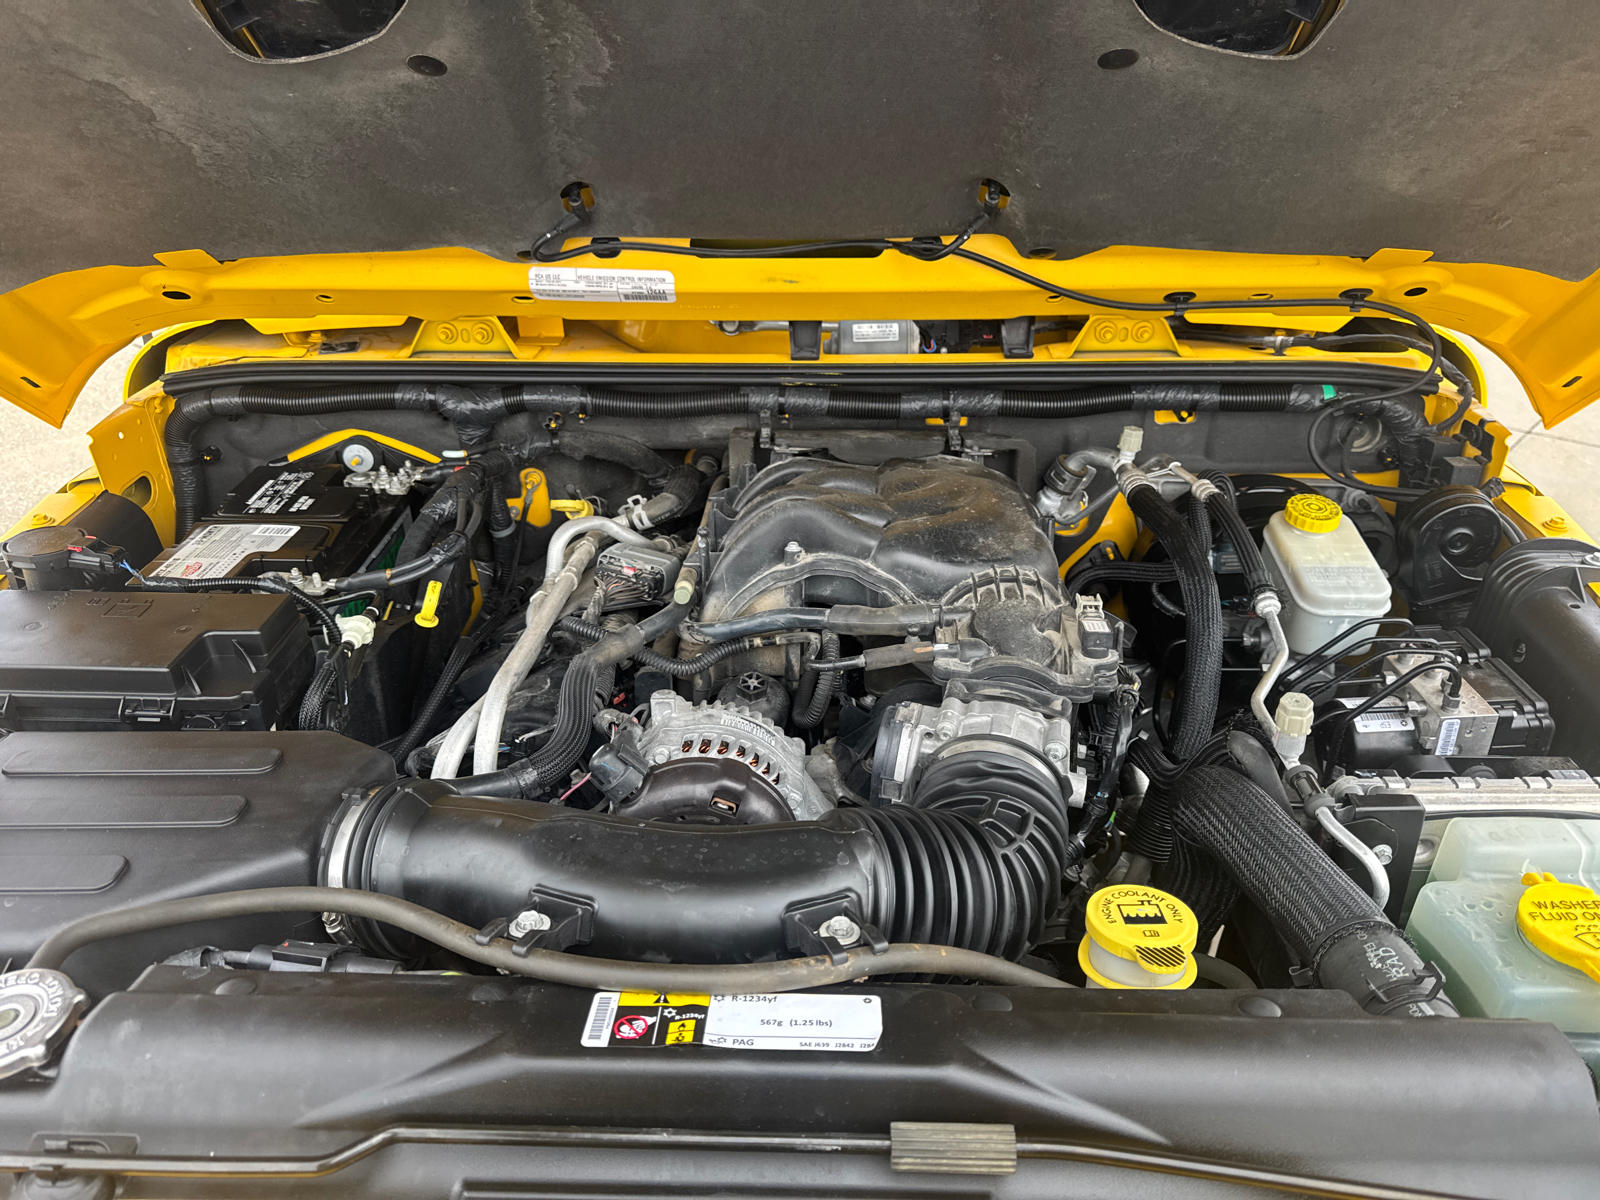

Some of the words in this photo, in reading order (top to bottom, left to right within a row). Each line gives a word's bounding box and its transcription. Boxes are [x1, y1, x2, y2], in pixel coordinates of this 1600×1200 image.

[1102, 898, 1117, 924] ENGINE
[1112, 890, 1167, 903] COOLANT
[1166, 904, 1184, 923] ONLY
[1531, 900, 1600, 910] WASHER
[1528, 911, 1579, 921] FLUID
[1379, 947, 1410, 977] RAD
[731, 995, 778, 1004] R-1234yf
[760, 1019, 783, 1027] 567g
[789, 1018, 814, 1028] (1.25
[815, 1019, 833, 1028] lbs)
[732, 1037, 755, 1047] PAG
